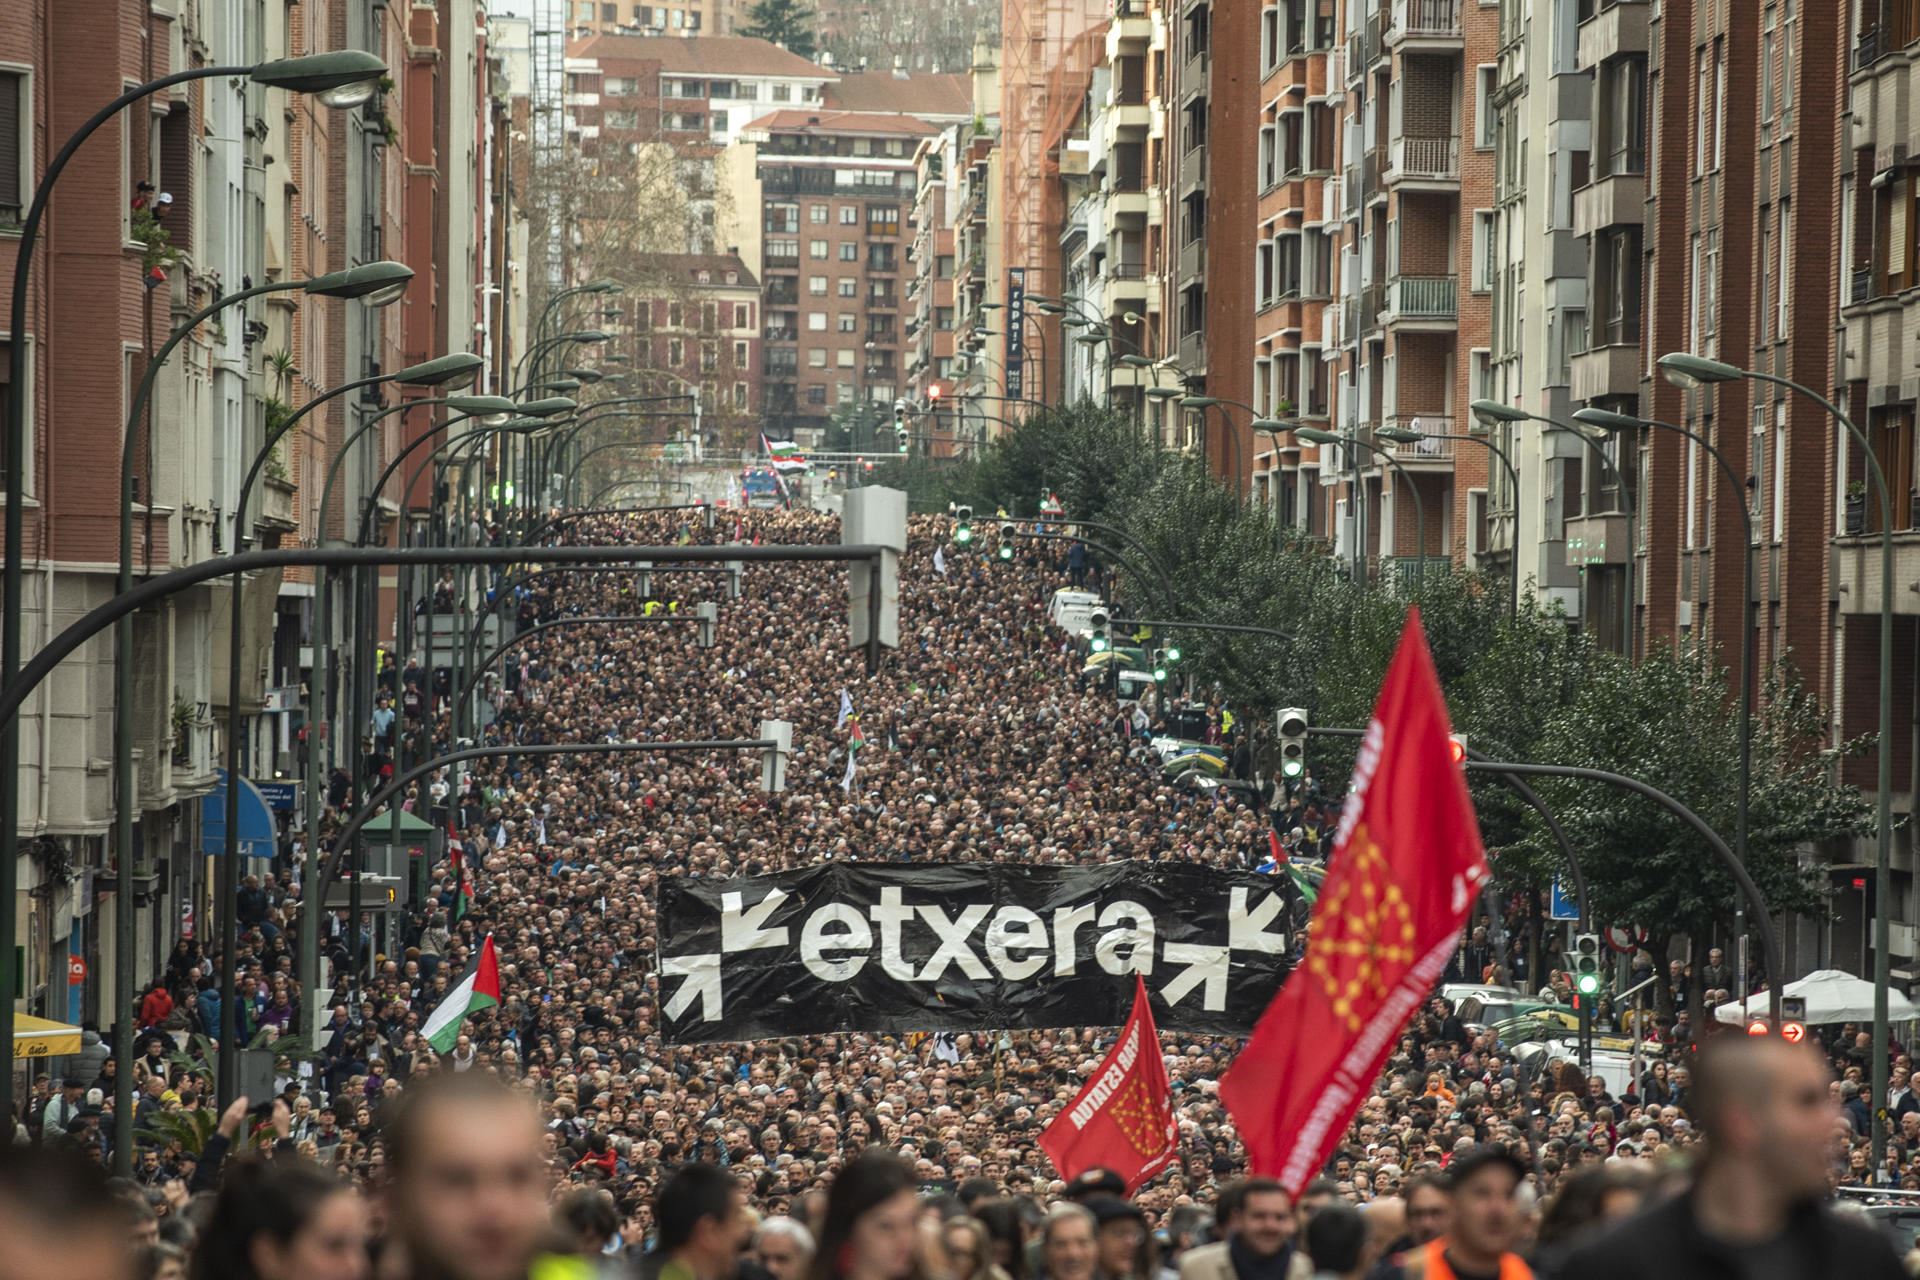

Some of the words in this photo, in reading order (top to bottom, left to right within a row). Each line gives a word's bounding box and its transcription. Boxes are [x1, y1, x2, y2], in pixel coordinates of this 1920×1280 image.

[1011, 291, 1020, 351] repair
[799, 886, 1157, 983] etxera
[27, 1042, 48, 1055] año
